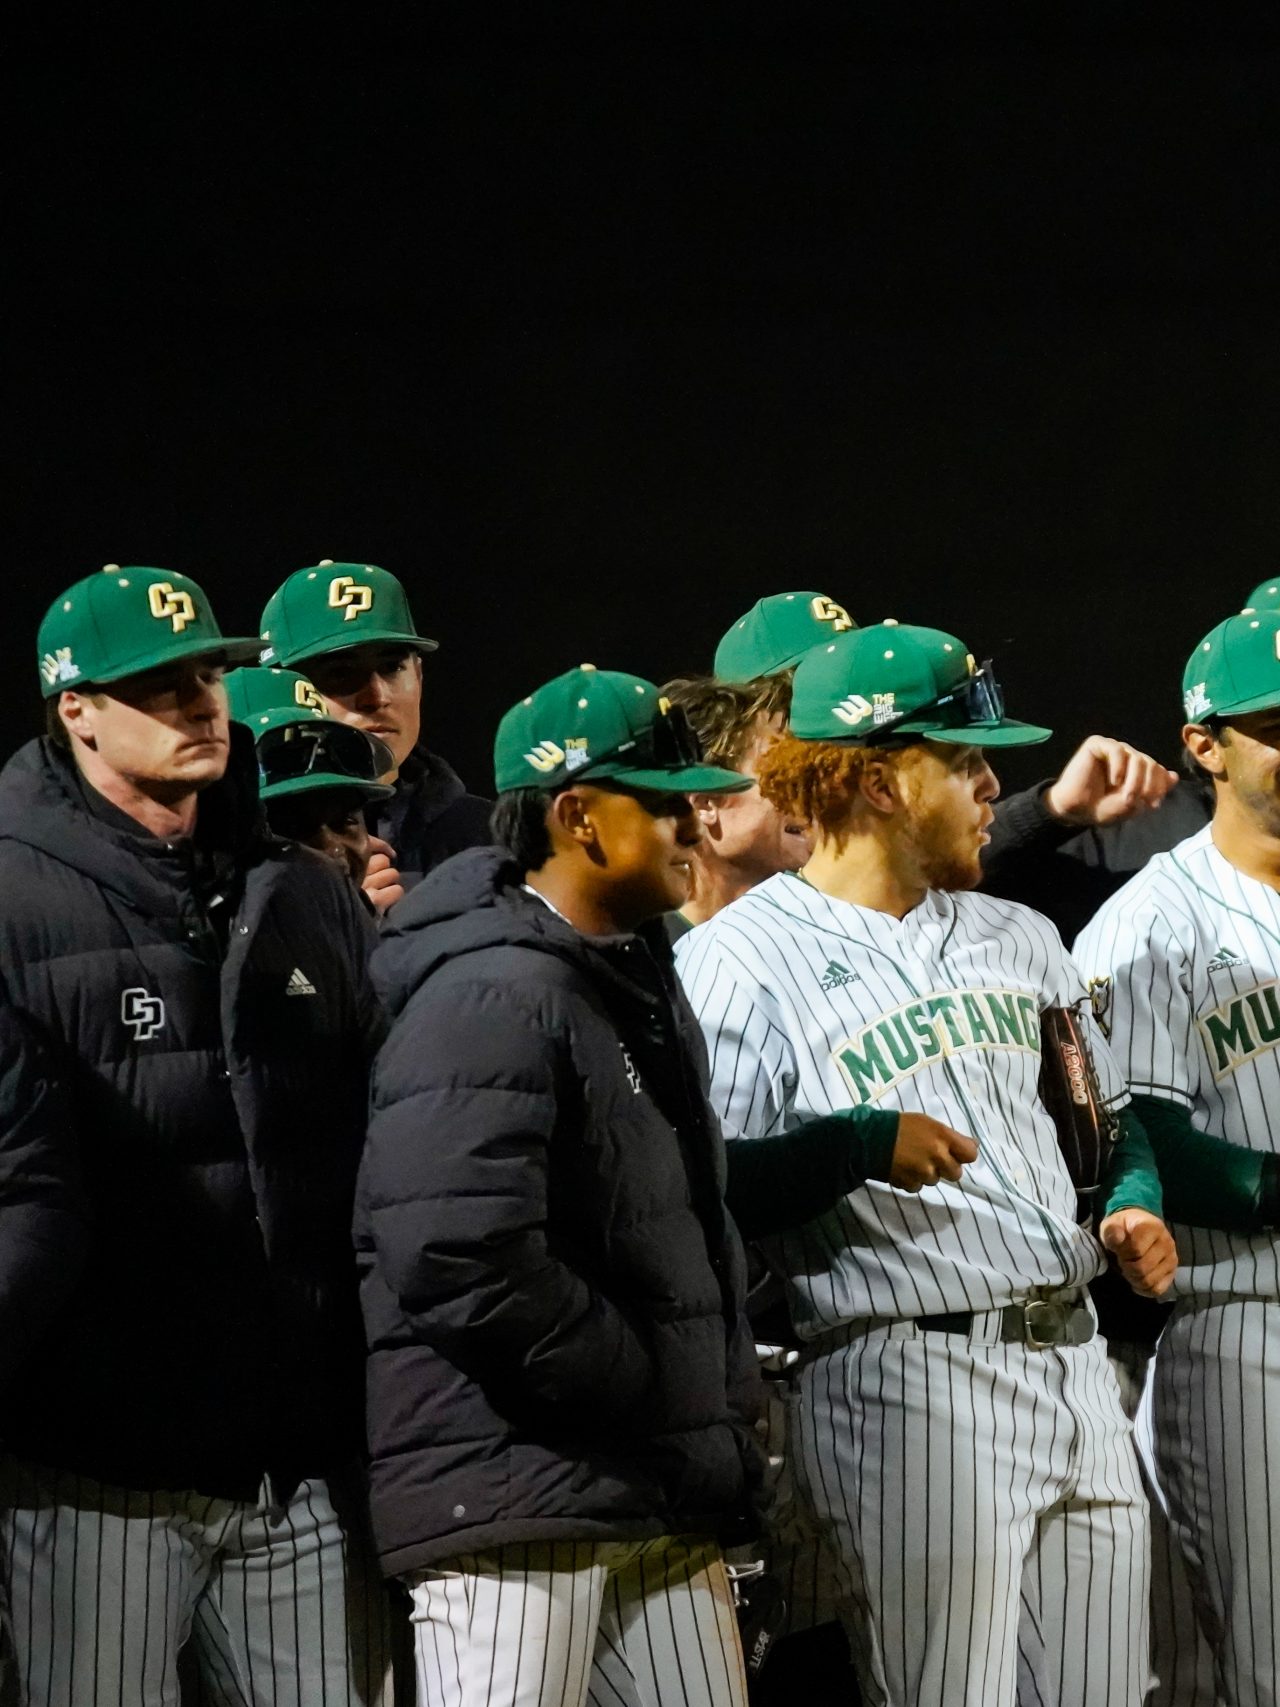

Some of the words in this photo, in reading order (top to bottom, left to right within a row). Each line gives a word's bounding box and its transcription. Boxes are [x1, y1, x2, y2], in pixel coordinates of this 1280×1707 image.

[148, 581, 196, 633] CP
[328, 576, 373, 621] CP
[872, 692, 895, 705] THE
[820, 972, 862, 992] adidas
[121, 987, 165, 1041] CP
[835, 990, 1041, 1108] MUSTANG
[1060, 1041, 1088, 1105] A2000
[748, 1630, 771, 1672] LL-STAR
